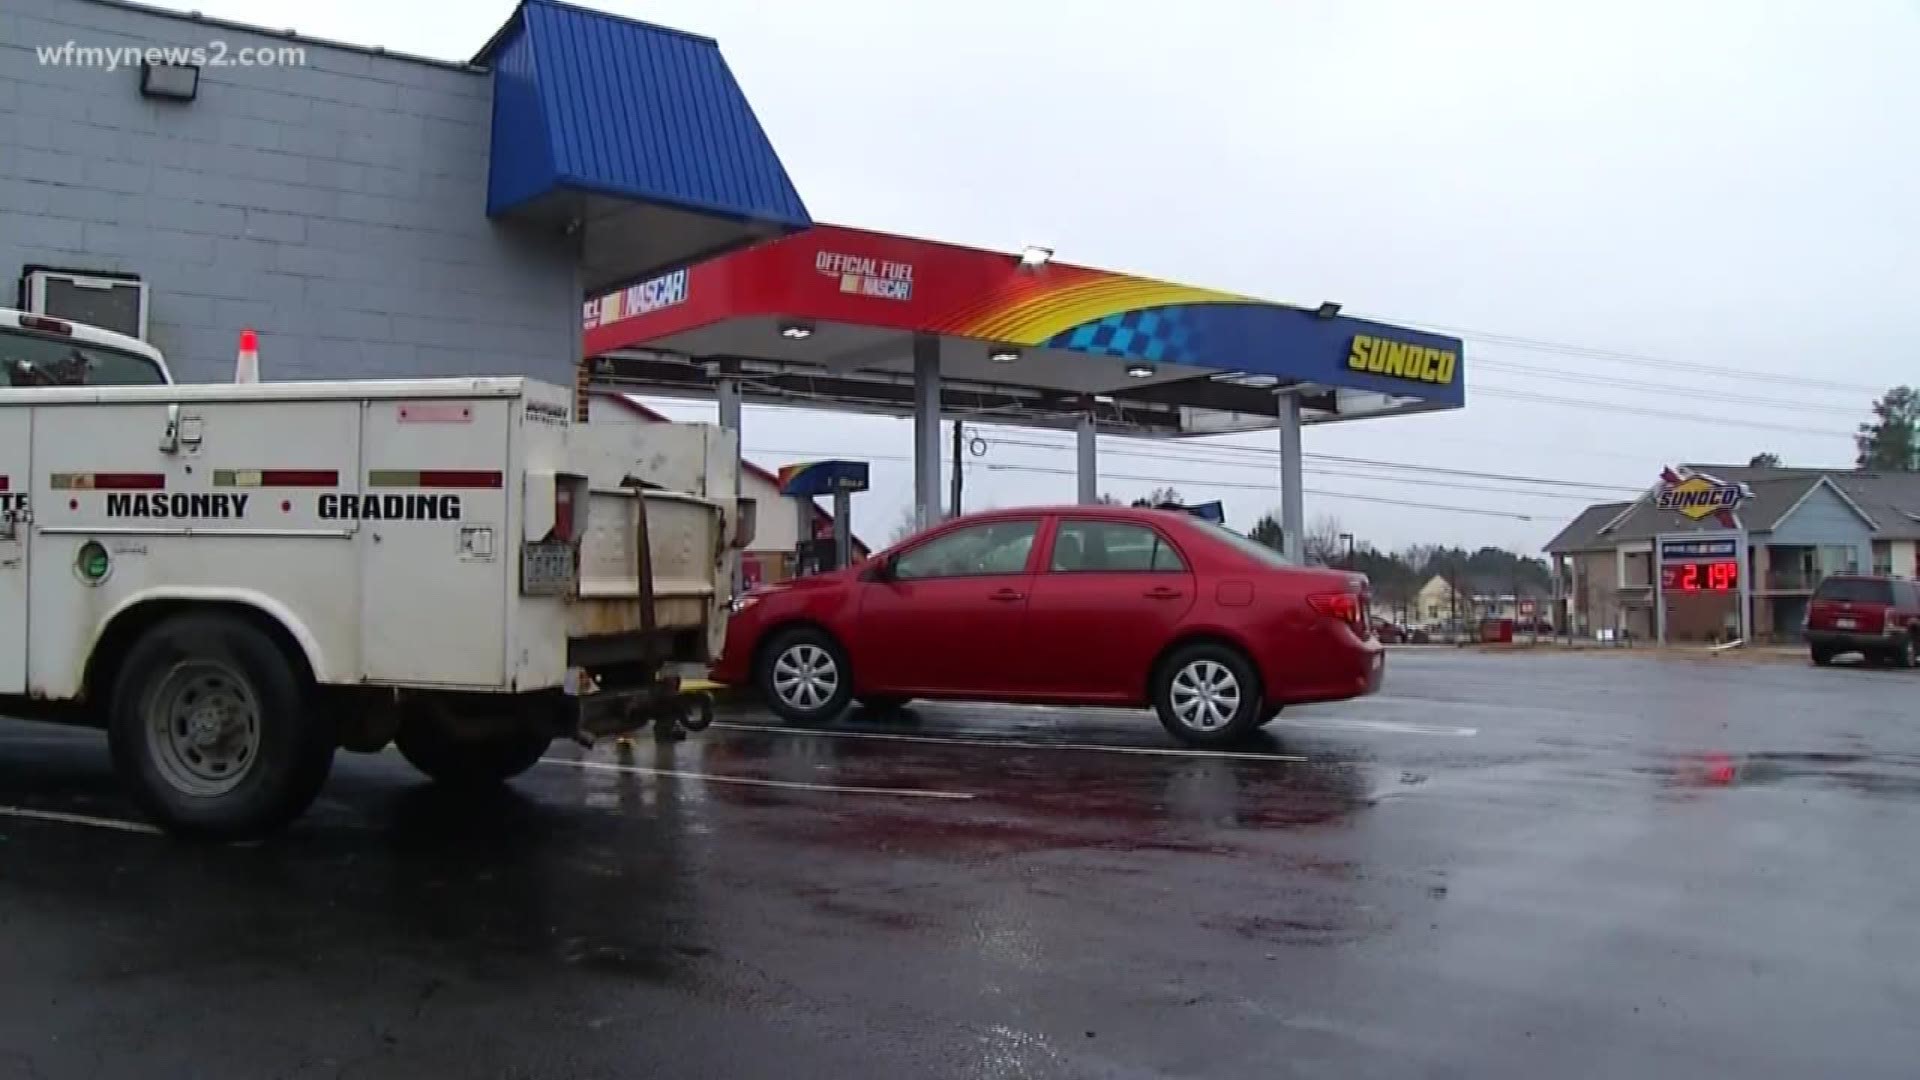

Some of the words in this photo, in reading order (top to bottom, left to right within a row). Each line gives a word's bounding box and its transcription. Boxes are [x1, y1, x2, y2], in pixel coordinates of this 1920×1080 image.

[816, 251, 878, 276] OFFICIAL
[881, 261, 913, 280] FUEL
[626, 269, 685, 316] NASCAR
[864, 276, 909, 300] NASCAR
[1348, 334, 1457, 385] SUNOCO
[106, 492, 249, 518] MASONRY
[318, 493, 461, 521] GRADING
[1659, 488, 1738, 509] SUNOCO
